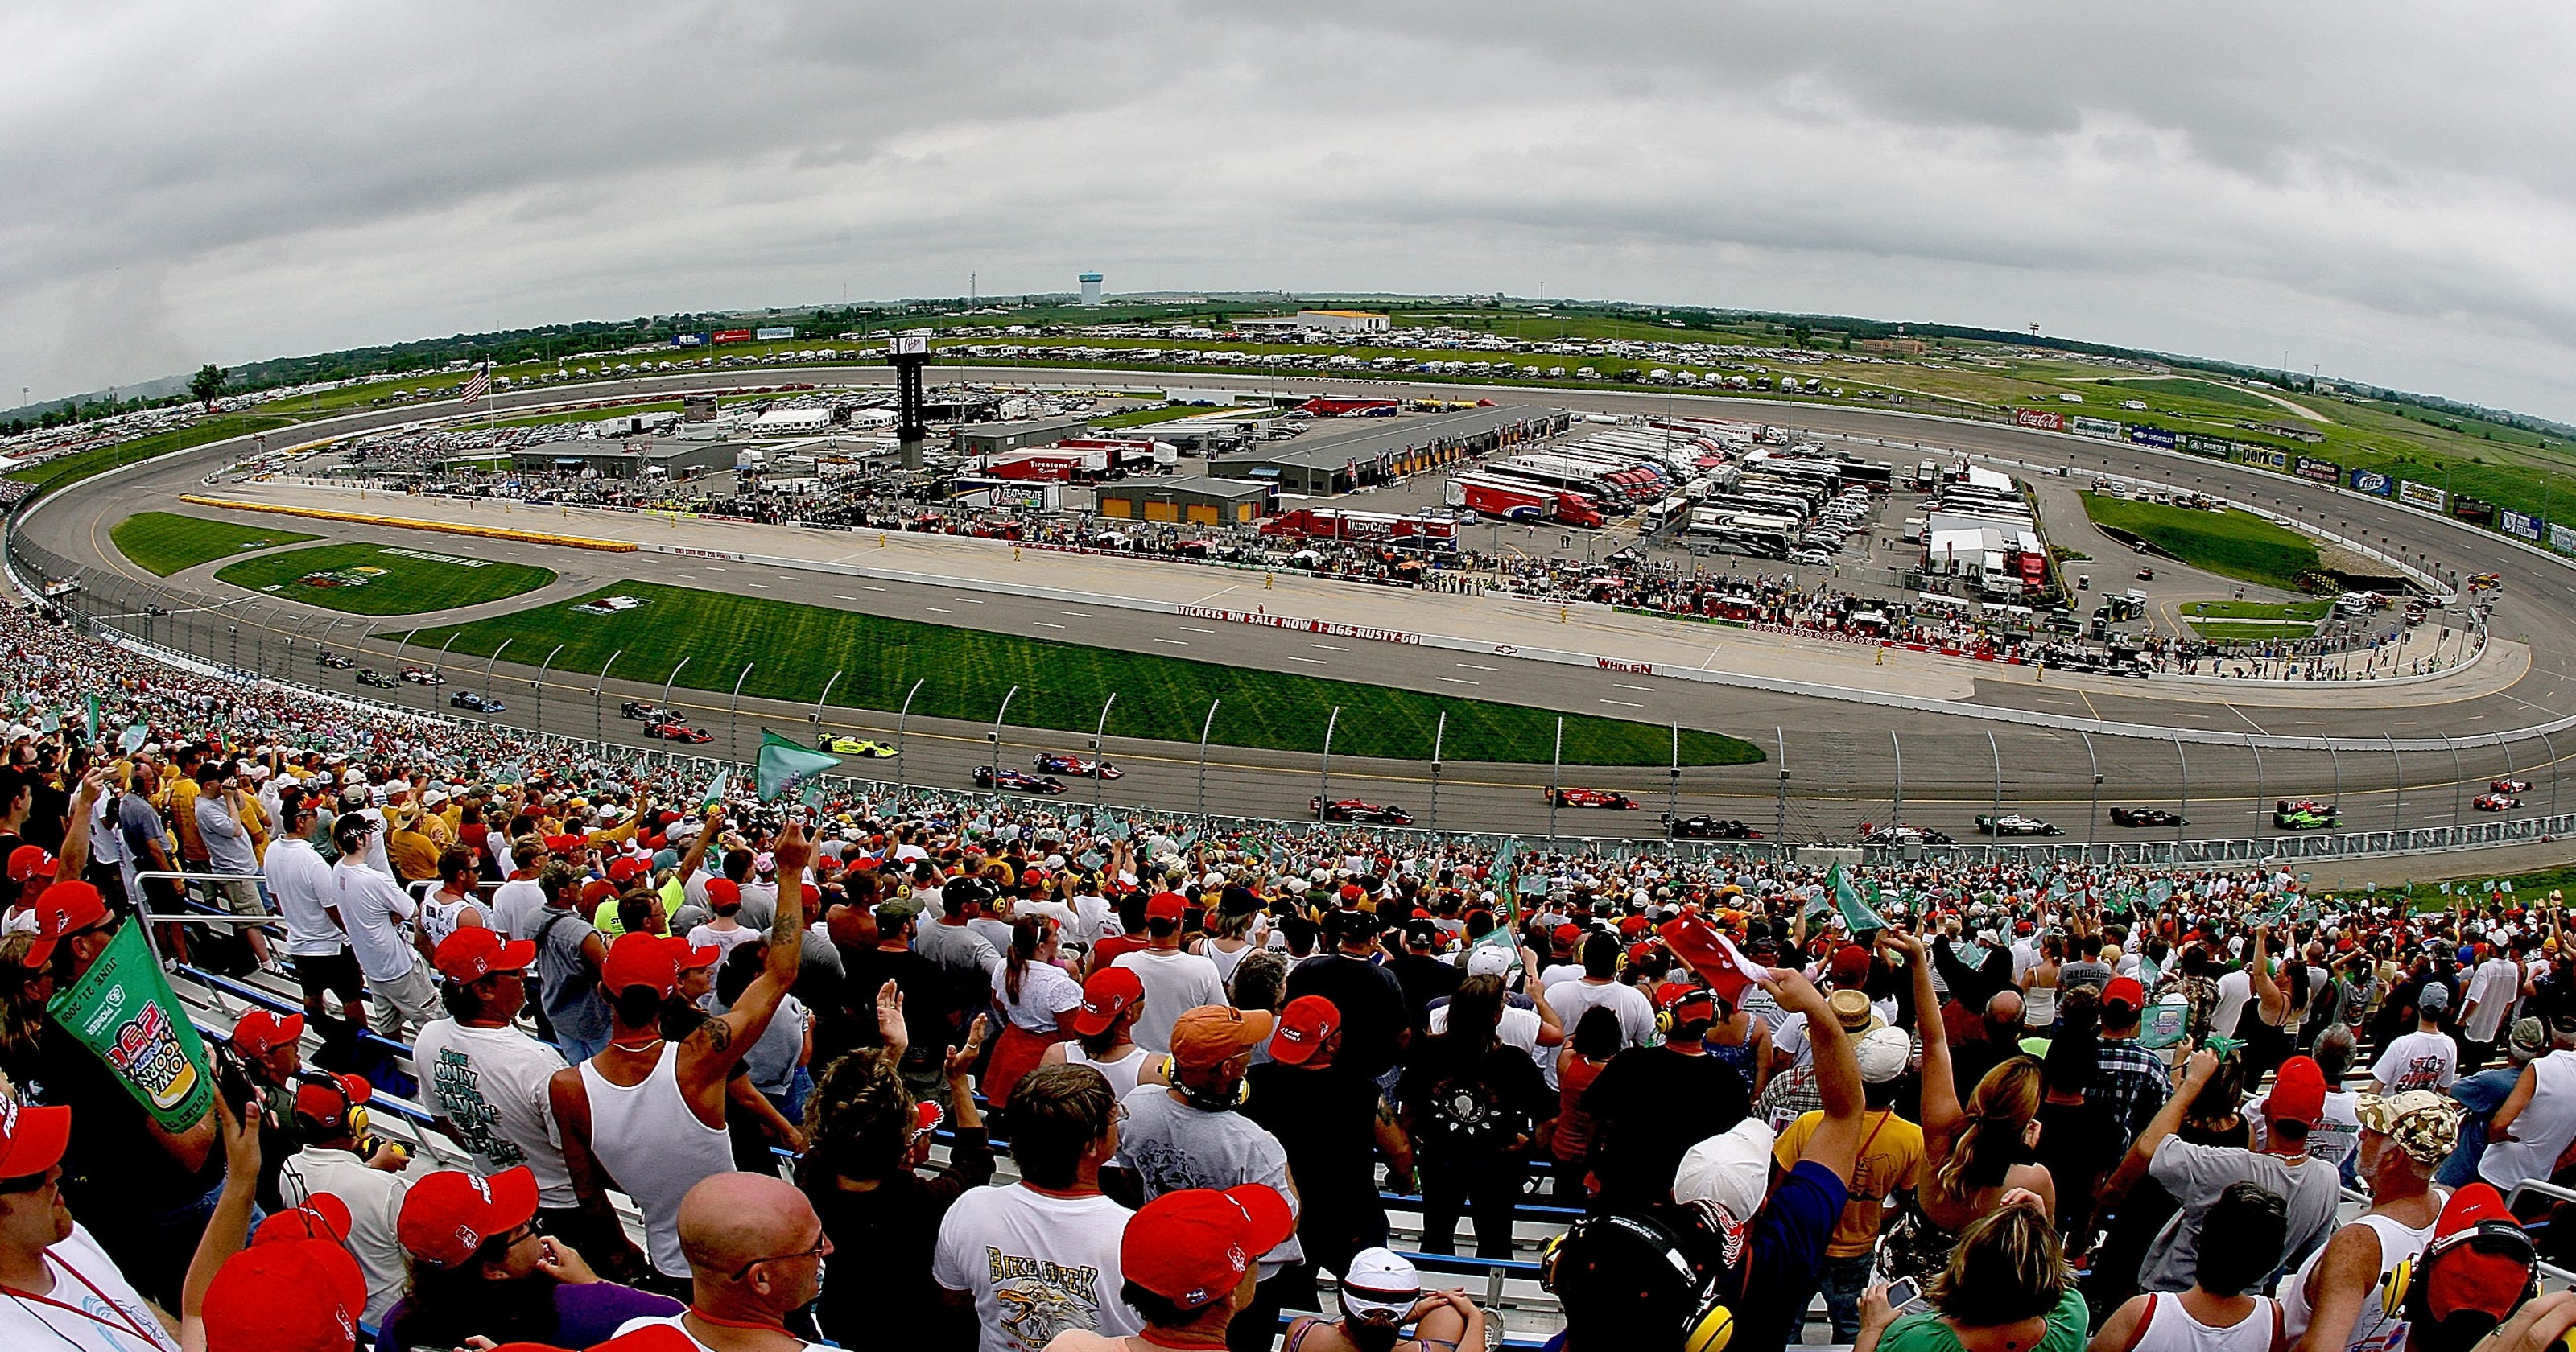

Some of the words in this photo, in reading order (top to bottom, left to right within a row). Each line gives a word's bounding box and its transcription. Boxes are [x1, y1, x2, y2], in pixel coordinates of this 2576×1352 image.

[1030, 460, 1067, 468] Firestone
[2242, 449, 2271, 465] pork
[1179, 605, 1224, 620] TICKETS
[1227, 612, 1245, 622] ON
[1249, 614, 1278, 627] SALE
[1281, 618, 1312, 631] NOW
[1317, 622, 1421, 645] 1-866-RUSTY-GO
[1596, 657, 1652, 674] WHELEN
[93, 957, 118, 986] JUNE
[77, 985, 95, 1000] 21,
[61, 1001, 82, 1023] 2009
[86, 1005, 114, 1036] PIONEER
[134, 1038, 163, 1074] INDY
[138, 1042, 175, 1086] CORN
[440, 1047, 469, 1068] THE
[147, 1048, 188, 1097] IOWA
[434, 1061, 479, 1090] ONLY
[986, 1245, 1040, 1285] BIKE
[1041, 1260, 1100, 1309] WEEK
